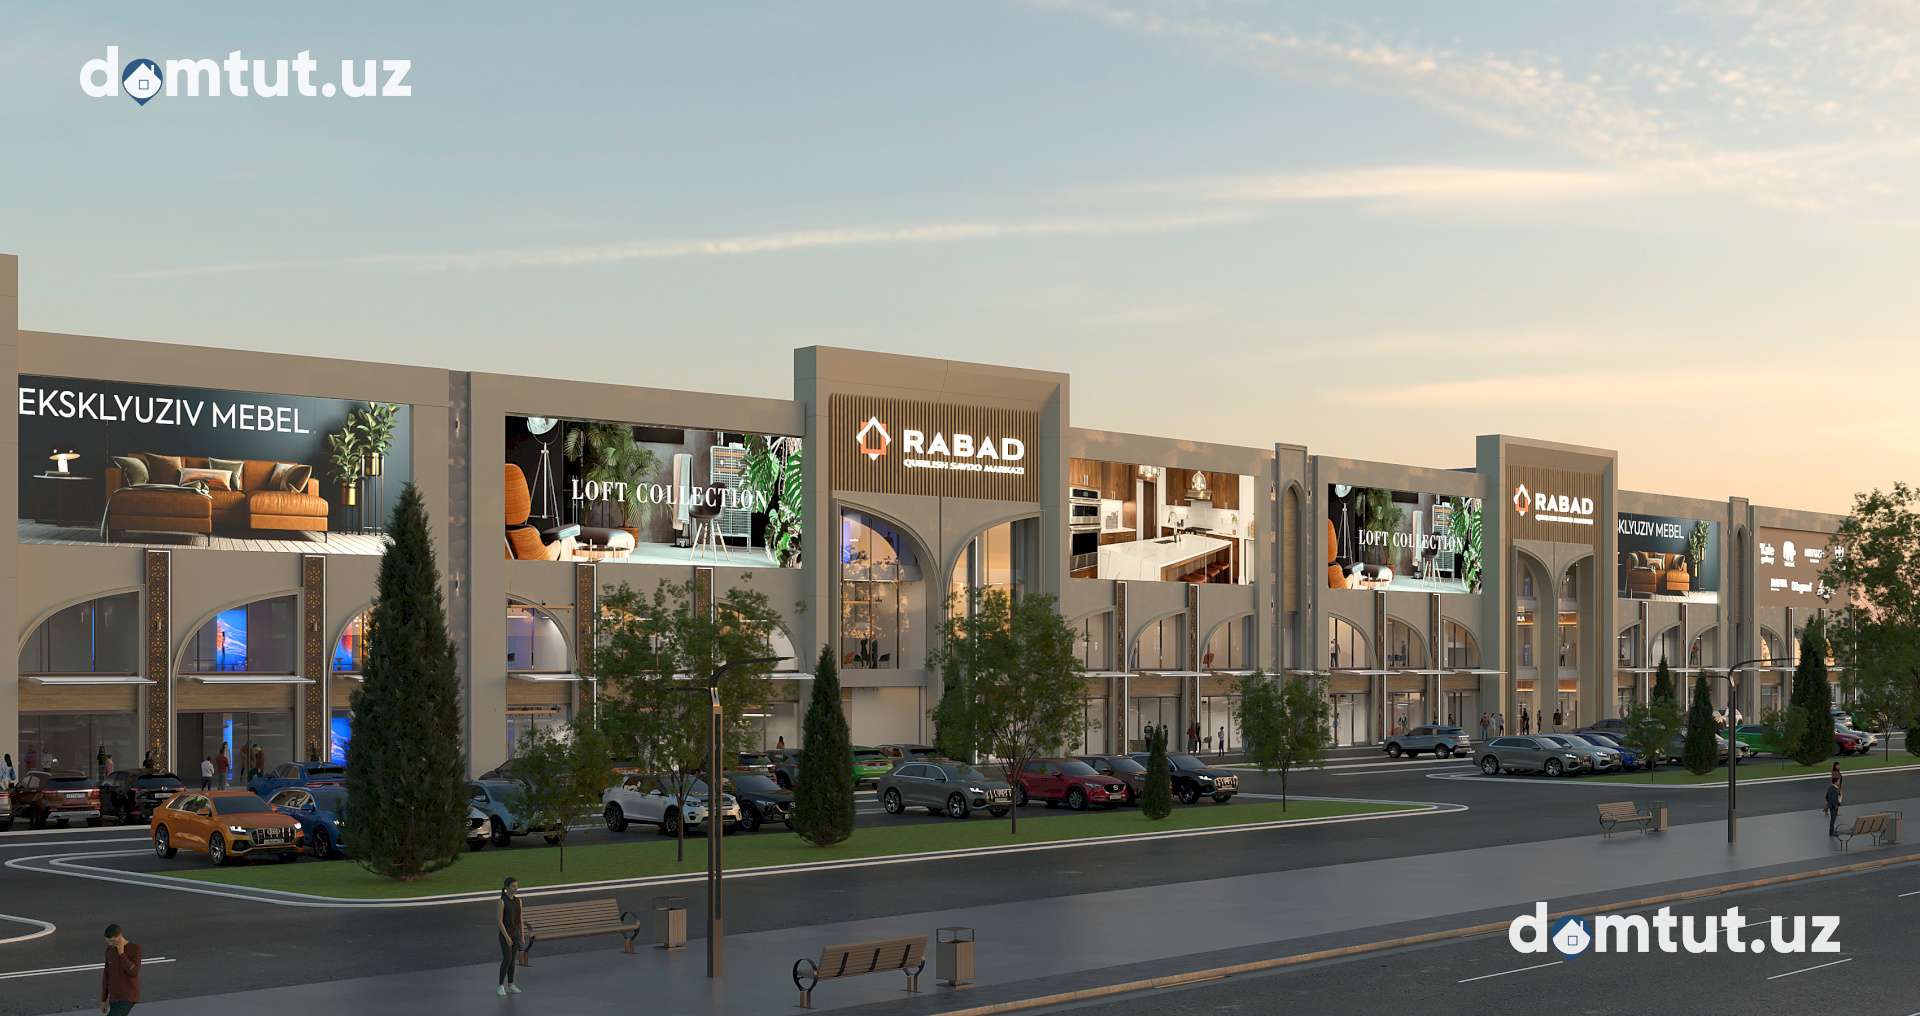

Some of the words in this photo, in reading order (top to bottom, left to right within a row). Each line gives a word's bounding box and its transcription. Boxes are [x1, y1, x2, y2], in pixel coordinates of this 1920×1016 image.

[18, 387, 205, 427] EKSKLYUZIV
[212, 402, 310, 435] MEBEL
[903, 429, 1025, 461] RABAD
[571, 478, 628, 502] LOFT
[636, 482, 768, 511] COLLECTION
[1535, 492, 1594, 515] RABAD
[1358, 529, 1389, 547] LOFT
[1392, 532, 1464, 551] COLLECTION
[1618, 519, 1655, 536] KLYUZIV
[1655, 522, 1685, 539] MEBEL
